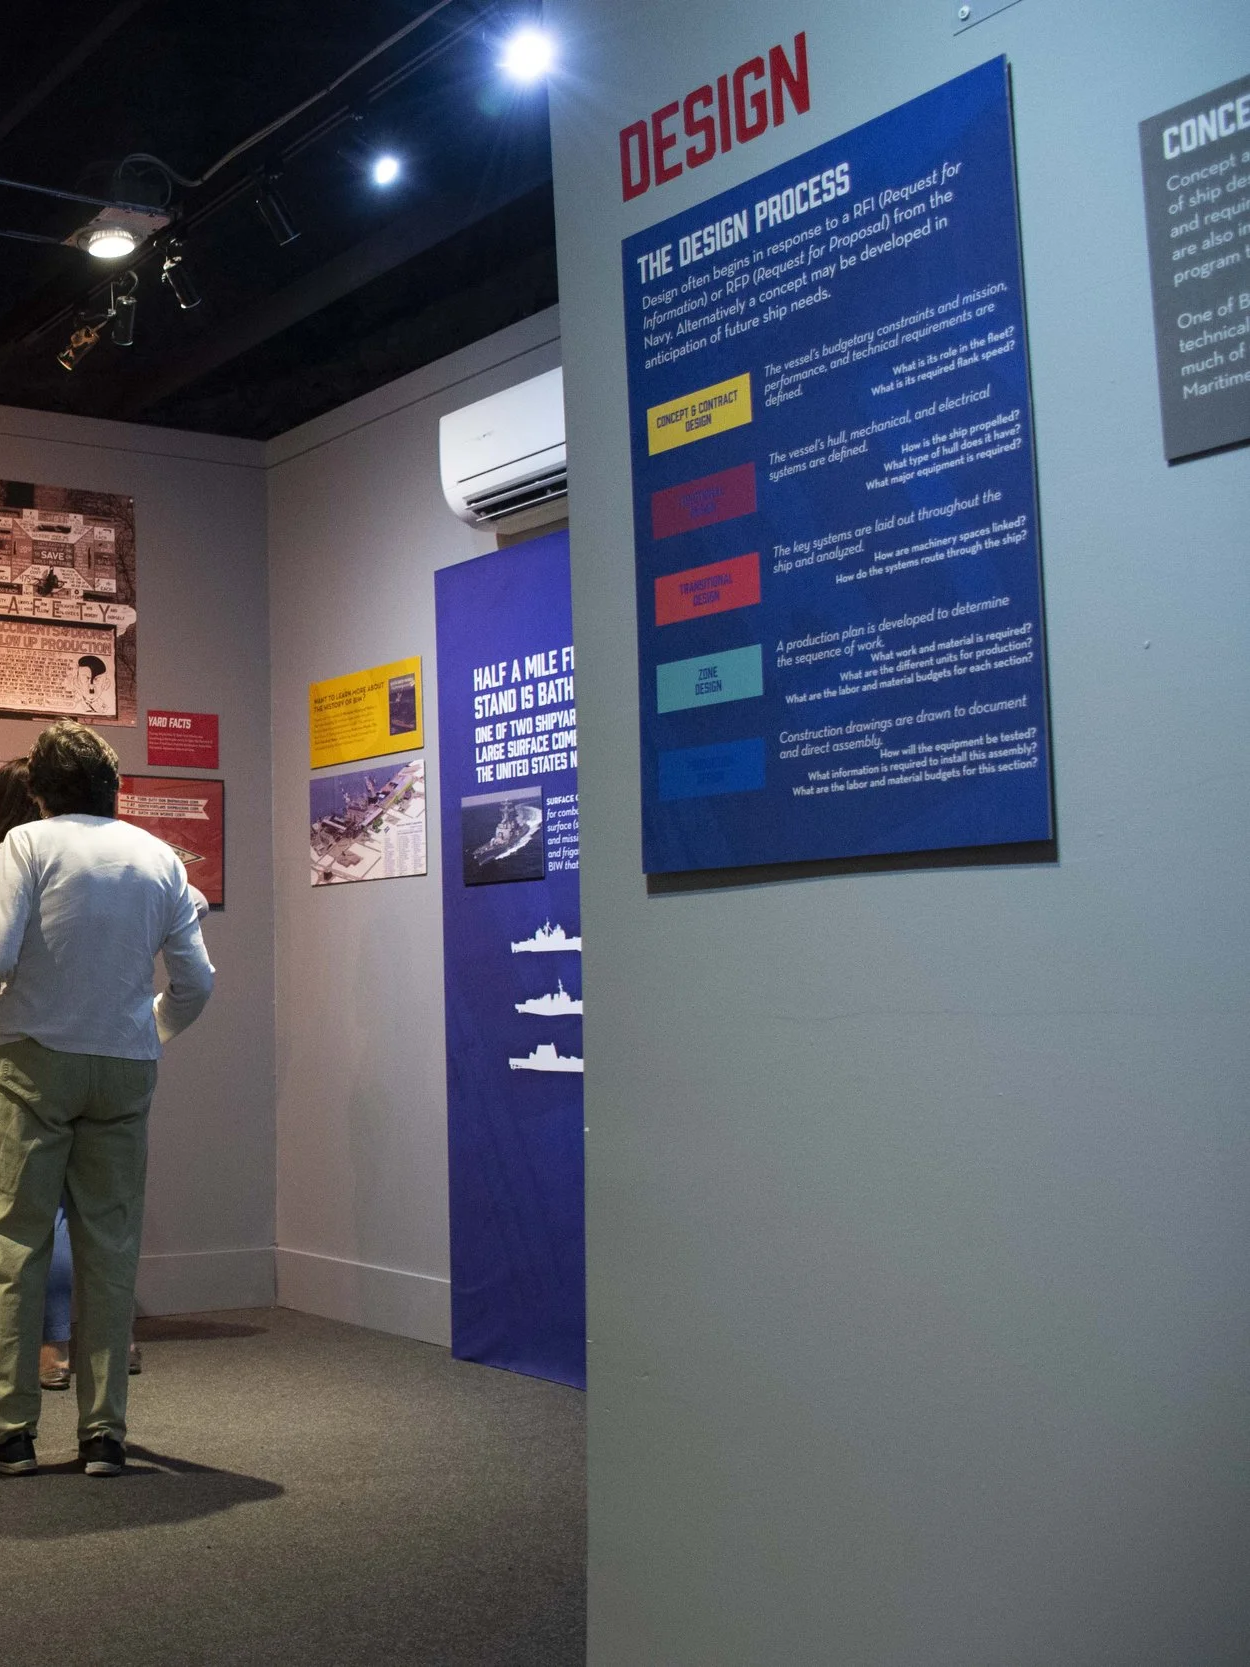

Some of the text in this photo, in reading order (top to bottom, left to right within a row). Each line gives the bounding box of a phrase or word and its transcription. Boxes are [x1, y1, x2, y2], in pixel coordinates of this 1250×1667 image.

[619, 31, 810, 203] DESIGN
[1166, 152, 1236, 191] Concept
[1169, 194, 1184, 215] of
[1189, 186, 1222, 207] ship
[637, 162, 850, 283] THE DESIGN PROCESS
[642, 162, 962, 309] Design often begins in response to a RFI (Request for
[1170, 213, 1199, 238] and
[643, 190, 953, 329] Information) or RFP (Request for Proposal) from the
[1172, 231, 1233, 261] are also
[644, 215, 948, 348] Navy. Alternatively a concept may be developed in
[1174, 252, 1240, 287] program
[645, 285, 831, 369] anticipation of future ship needs.
[1177, 296, 1234, 329] One of
[764, 302, 995, 395] performance, and technical requirements are
[1179, 316, 1250, 352] technical
[1181, 341, 1245, 376] much of
[656, 389, 737, 428] CONCEPT & CONTRACT
[685, 413, 712, 432] DESIGN
[769, 439, 868, 482] systems are defined.
[41, 551, 64, 560] SAVE
[776, 595, 1009, 653] A production plan is developed to determine
[24, 636, 37, 648] UP
[41, 639, 111, 653] PRODUCTION
[474, 662, 507, 691] HALF
[511, 659, 521, 683] A
[525, 650, 558, 680] MILE
[698, 667, 717, 681] ZONE
[336, 691, 351, 699] LEARN
[368, 682, 384, 691] ABOUT
[474, 676, 574, 719] STAND IS BATH
[694, 680, 722, 695] DESIGN
[324, 701, 343, 709] HISTORY
[149, 716, 191, 729] YARD FACTS
[475, 725, 493, 744] ONE
[496, 722, 507, 740] OF
[510, 717, 532, 737] TWO
[476, 743, 505, 764] LARGE
[508, 734, 549, 757] SURFACE
[880, 727, 1036, 757] How will the equipment be tested?
[476, 765, 494, 783] THE
[496, 759, 529, 780] UNITED
[531, 752, 567, 774] STATES
[546, 795, 574, 805] SURFACE
[546, 809, 556, 821] for
[547, 821, 571, 833] surface
[548, 834, 560, 845] and
[548, 847, 560, 858] and
[548, 861, 563, 871] BIW
